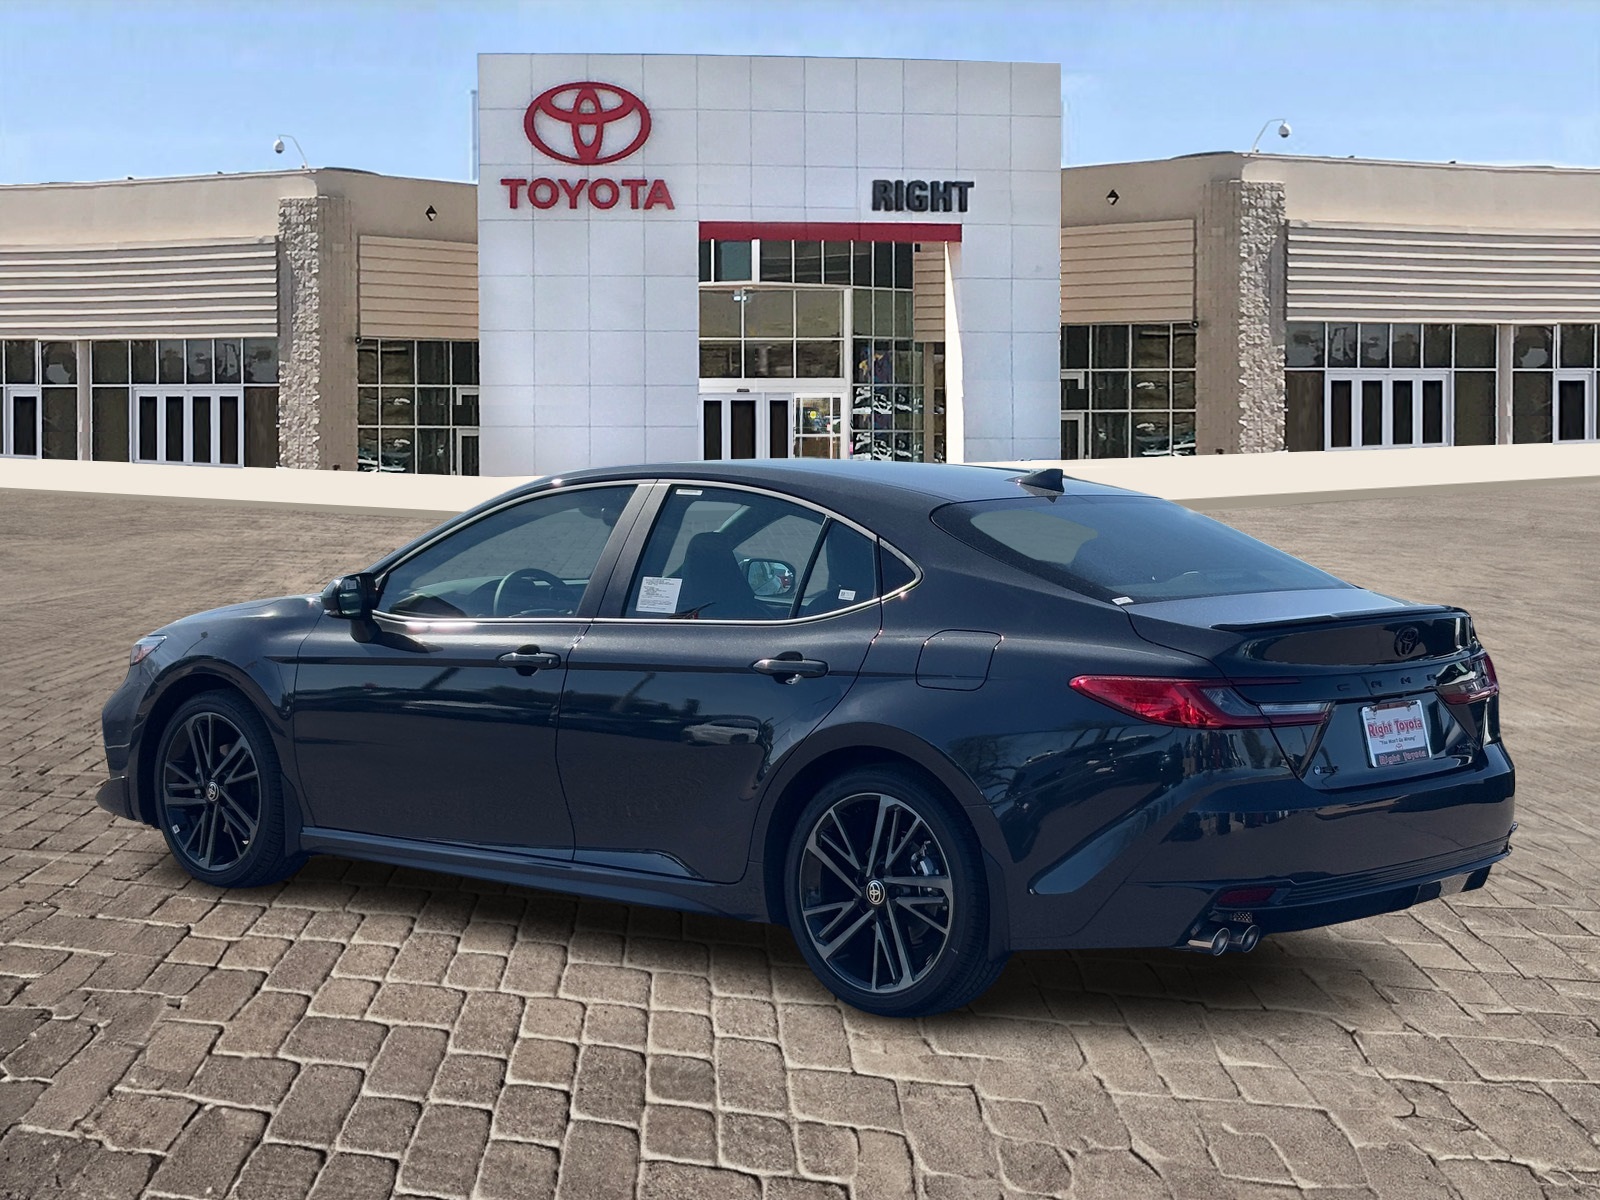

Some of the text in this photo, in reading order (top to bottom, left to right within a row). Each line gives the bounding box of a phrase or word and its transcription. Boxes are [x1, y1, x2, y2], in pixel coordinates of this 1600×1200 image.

[500, 177, 676, 210] TOYOTA
[871, 179, 975, 212] RIGHT
[1368, 717, 1423, 739] Right Toyota
[1379, 753, 1401, 765] Right
